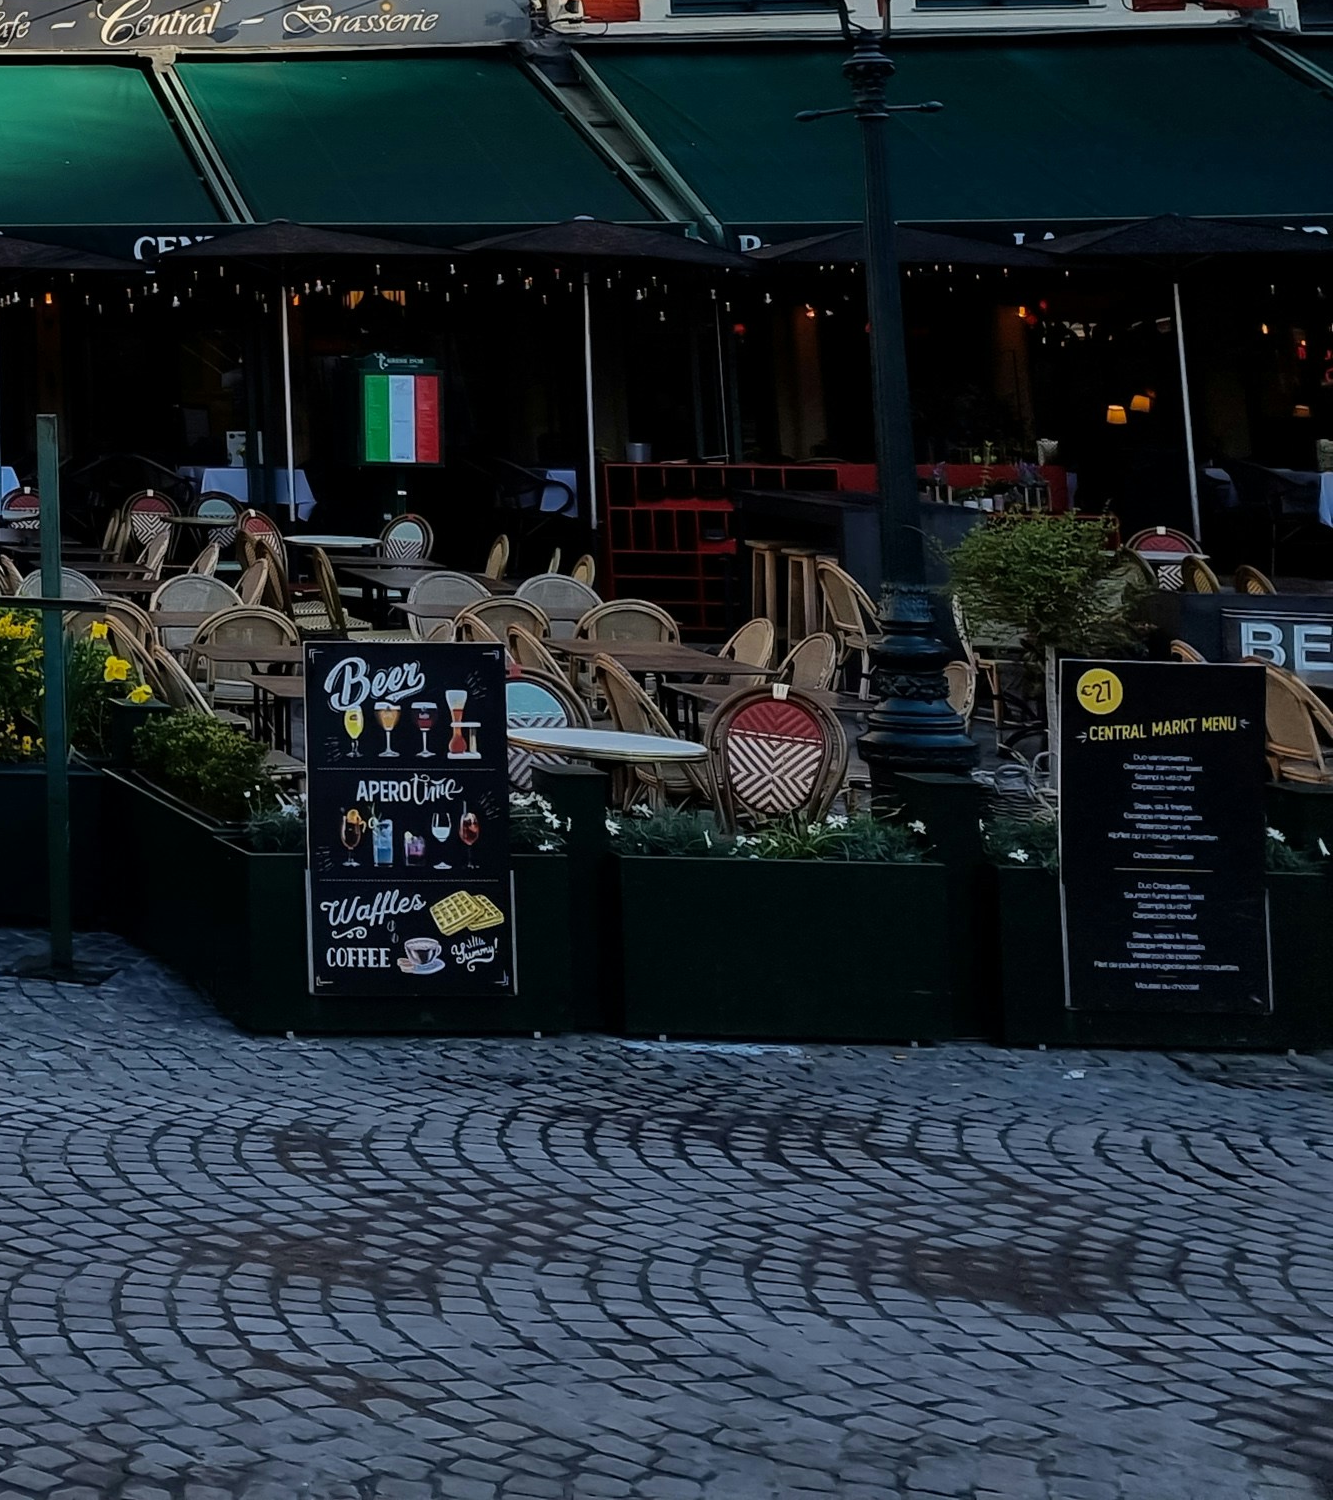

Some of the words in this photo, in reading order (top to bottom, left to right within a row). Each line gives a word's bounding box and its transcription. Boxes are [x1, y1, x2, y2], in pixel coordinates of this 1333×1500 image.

[283, 3, 440, 35] Brasserie
[323, 656, 426, 712] Beer
[1080, 679, 1112, 704] €27
[1089, 723, 1147, 741] CENTRAL
[1151, 717, 1198, 737] MARKT
[1201, 716, 1237, 732] MENU
[320, 889, 427, 927] Waffles
[326, 946, 391, 968] COFFEE
